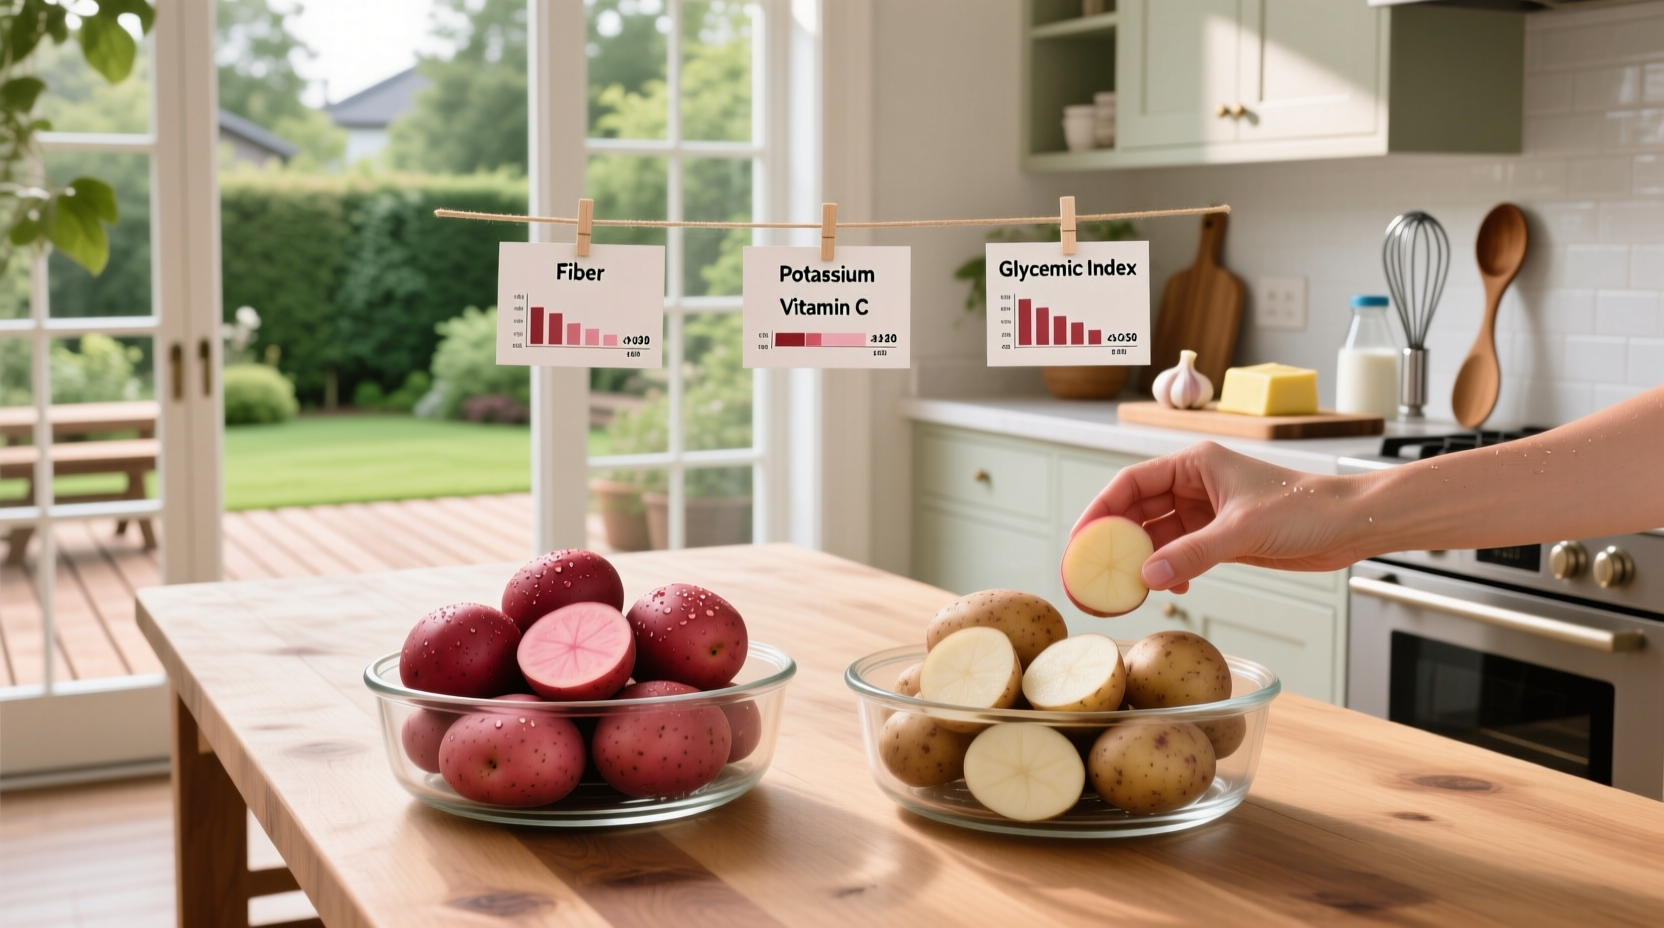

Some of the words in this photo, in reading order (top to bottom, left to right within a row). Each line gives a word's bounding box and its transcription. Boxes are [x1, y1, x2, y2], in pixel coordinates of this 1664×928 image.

[556, 262, 605, 281] Fiber
[779, 265, 875, 283] Potassium
[999, 259, 1083, 282] Glycemic
[1087, 258, 1137, 276] Index
[779, 297, 850, 316] Vitamin
[855, 298, 869, 315] C
